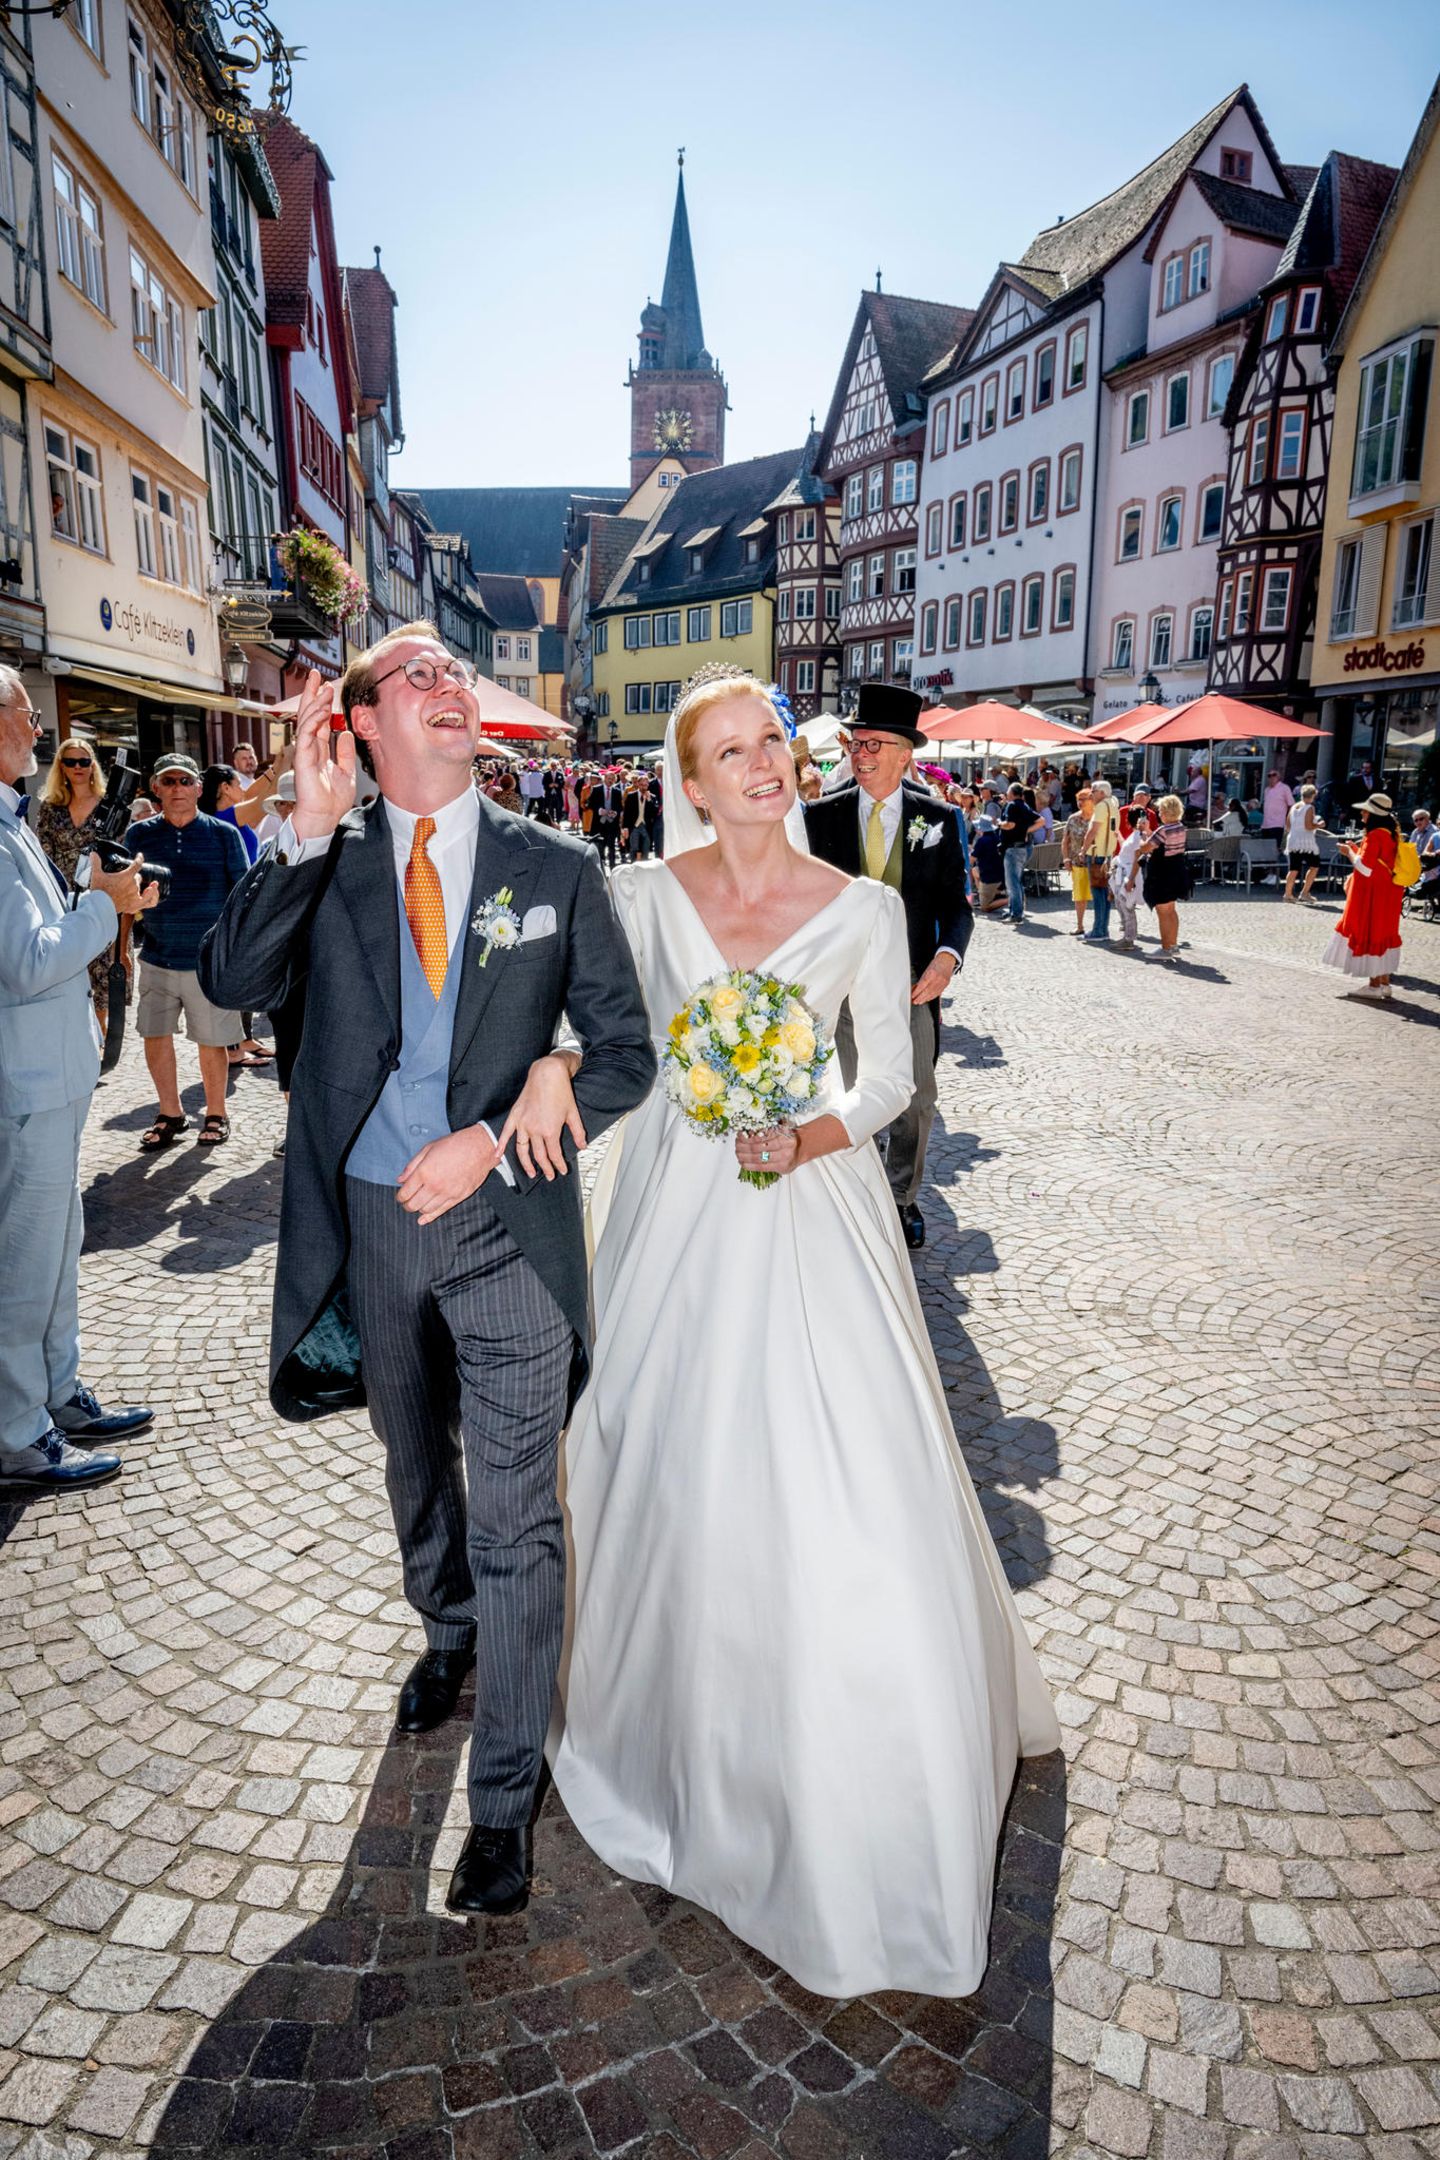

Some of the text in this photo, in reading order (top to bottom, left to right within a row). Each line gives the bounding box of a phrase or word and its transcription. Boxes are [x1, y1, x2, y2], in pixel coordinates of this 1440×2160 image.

[113, 600, 185, 647] Café Klitzeklein
[1343, 638, 1425, 672] stadtcafé
[1103, 700, 1128, 709] Gelato
